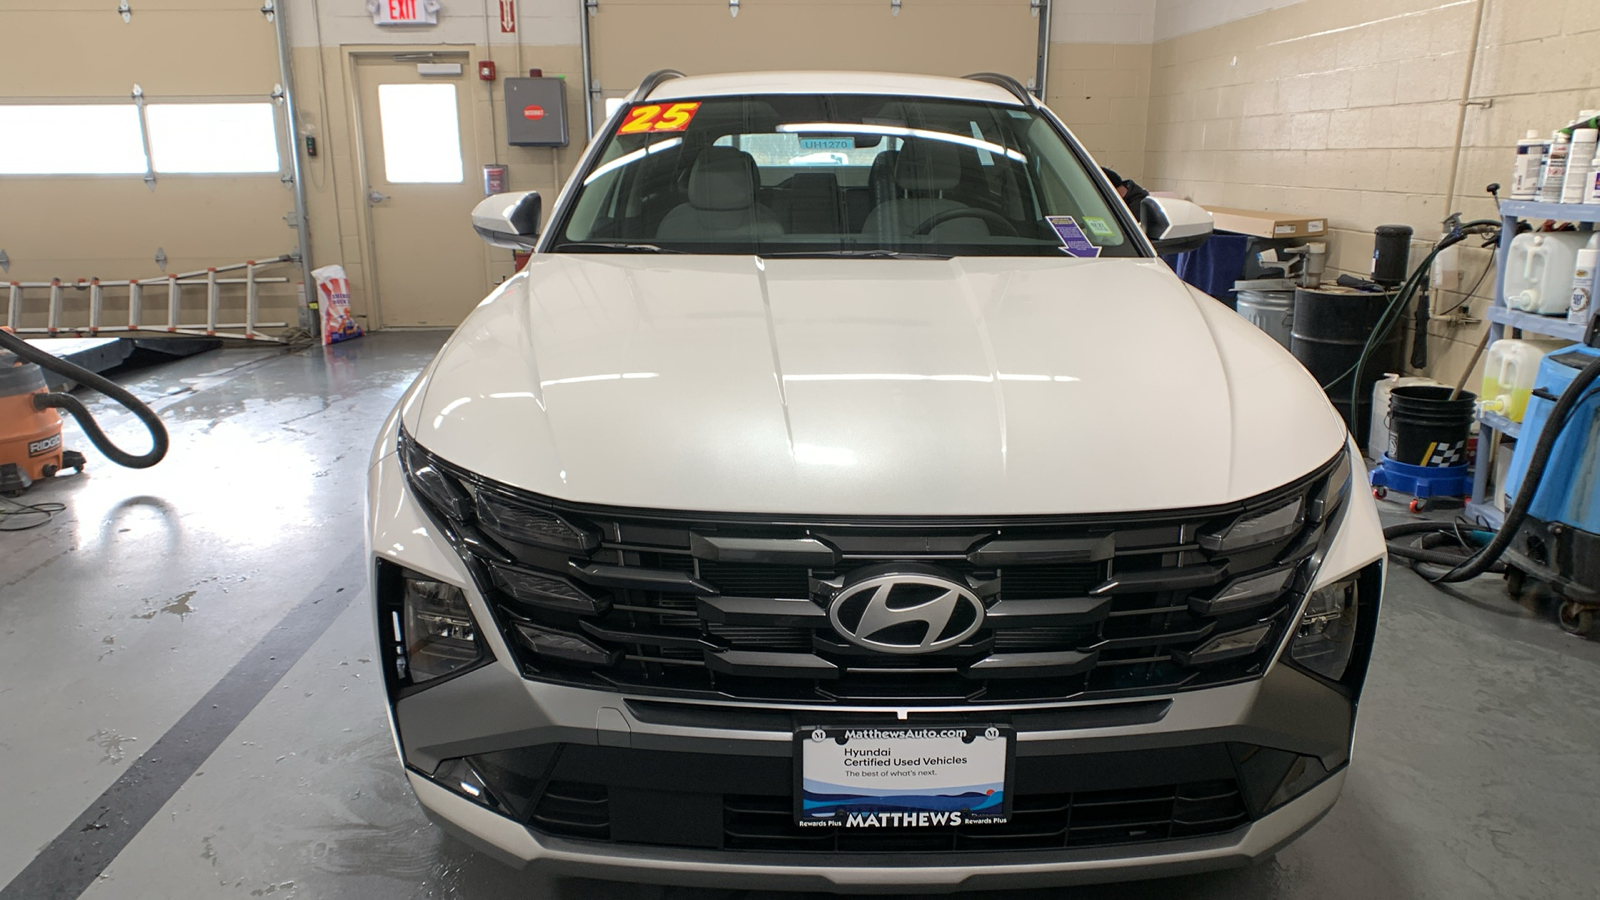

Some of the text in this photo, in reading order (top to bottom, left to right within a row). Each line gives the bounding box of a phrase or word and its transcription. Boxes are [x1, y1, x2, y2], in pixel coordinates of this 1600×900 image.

[388, 0, 417, 20] EXIT
[620, 102, 699, 133] 25
[805, 141, 848, 149] UH1270
[844, 728, 967, 741] MatthewsAuto.com
[844, 748, 891, 757] Hyundai
[844, 756, 968, 767] Certified Used Vehicles
[845, 811, 961, 828] MATTHEWS
